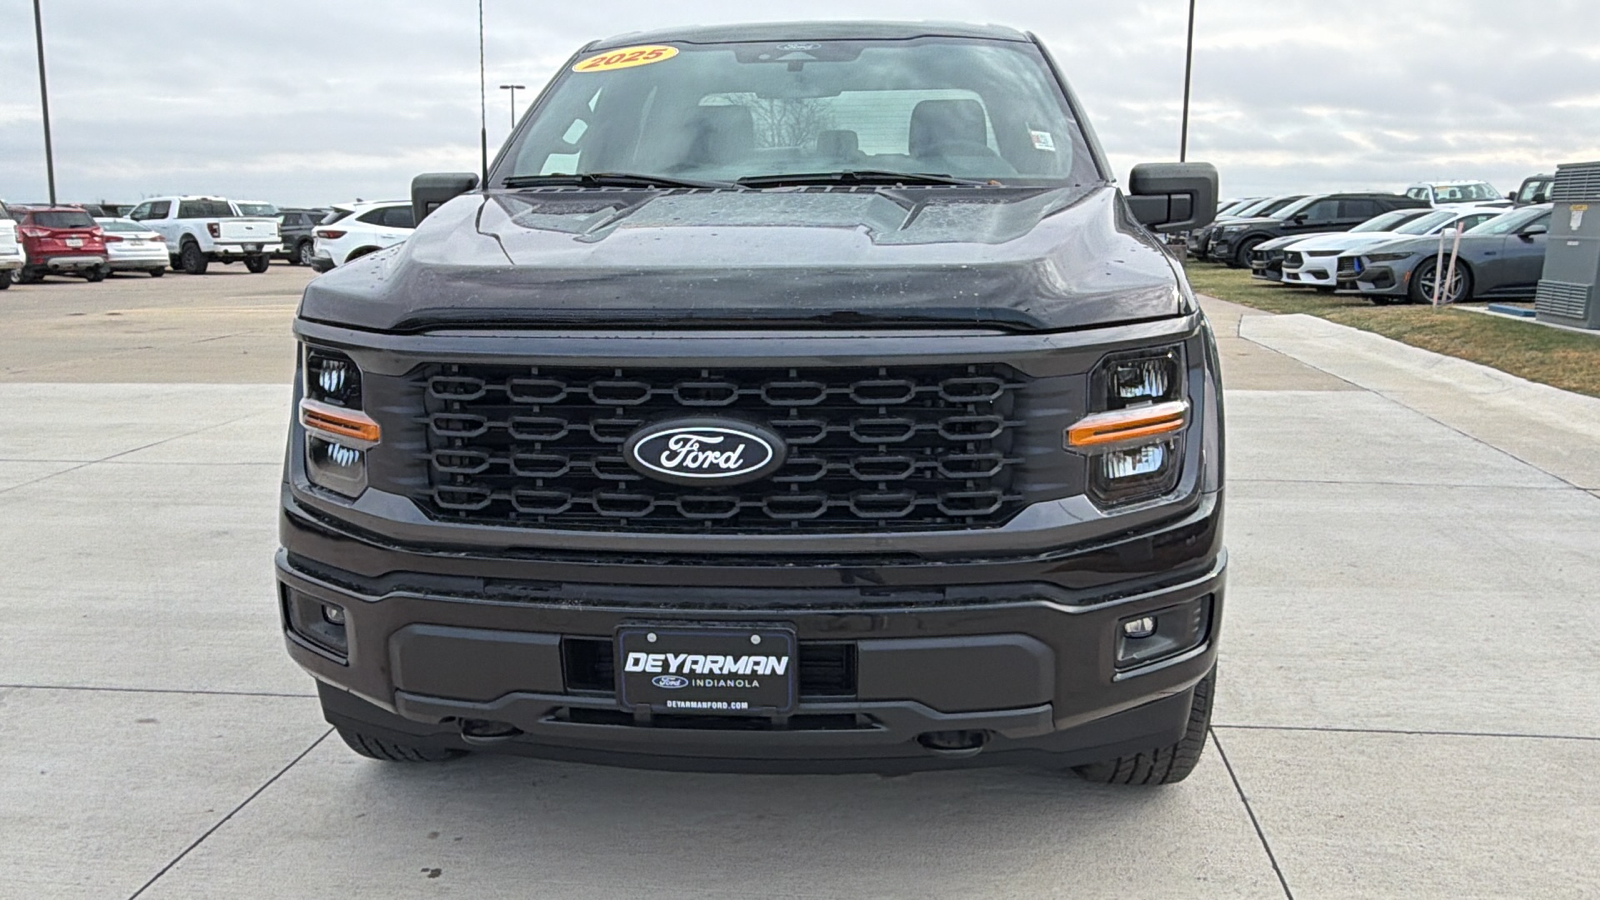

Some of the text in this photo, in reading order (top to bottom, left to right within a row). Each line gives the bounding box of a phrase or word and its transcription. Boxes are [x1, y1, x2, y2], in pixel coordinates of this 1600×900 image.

[581, 48, 668, 70] 2025
[660, 434, 746, 469] Ford
[624, 652, 789, 675] DEYARMAN
[659, 675, 760, 688] Ford INDIANOLA
[666, 700, 749, 709] DEYARMANFORD.COM
